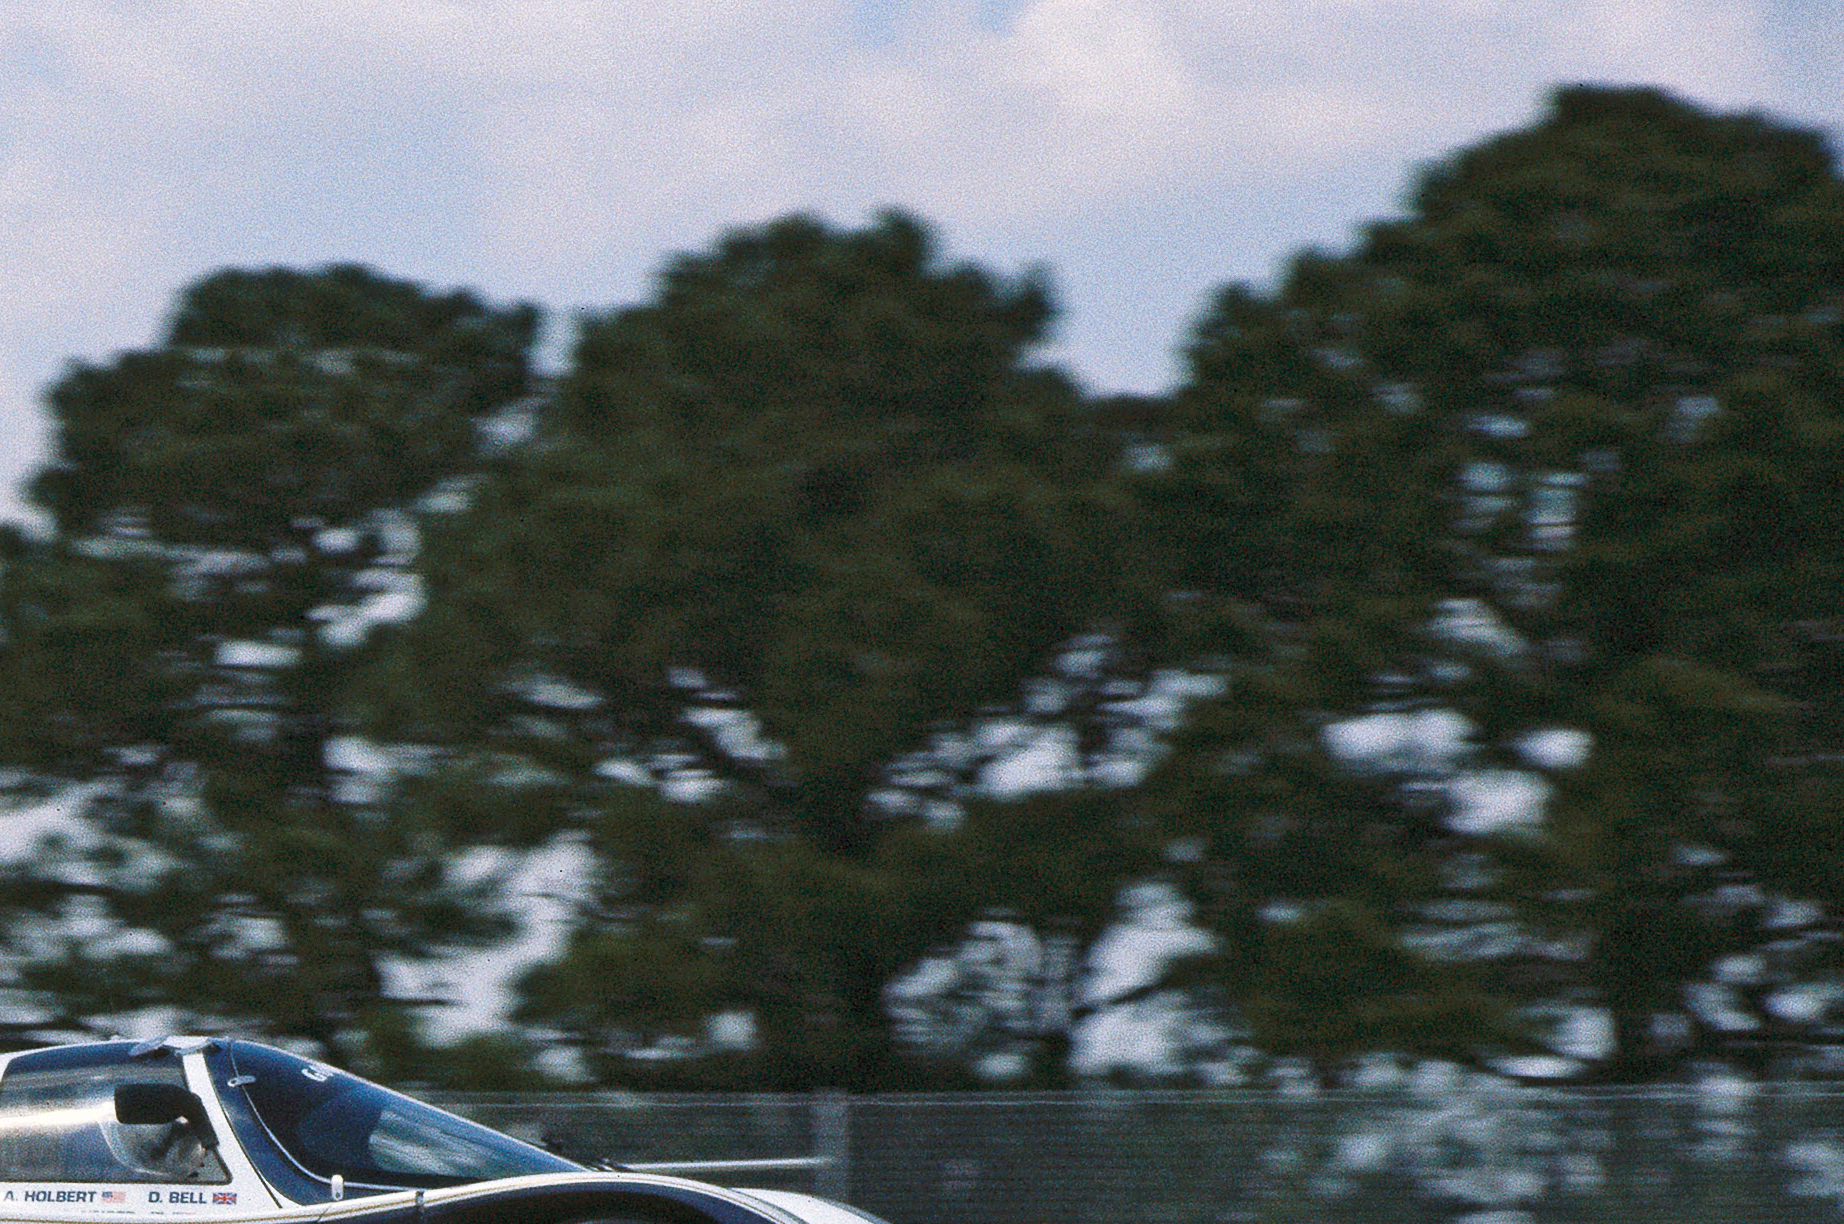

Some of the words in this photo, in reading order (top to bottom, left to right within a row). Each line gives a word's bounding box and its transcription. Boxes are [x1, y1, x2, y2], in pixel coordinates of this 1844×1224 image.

[4, 1191, 18, 1202] A.
[24, 1191, 97, 1203] HOLBERT
[148, 1191, 163, 1204] D.
[169, 1192, 207, 1205] BELL
